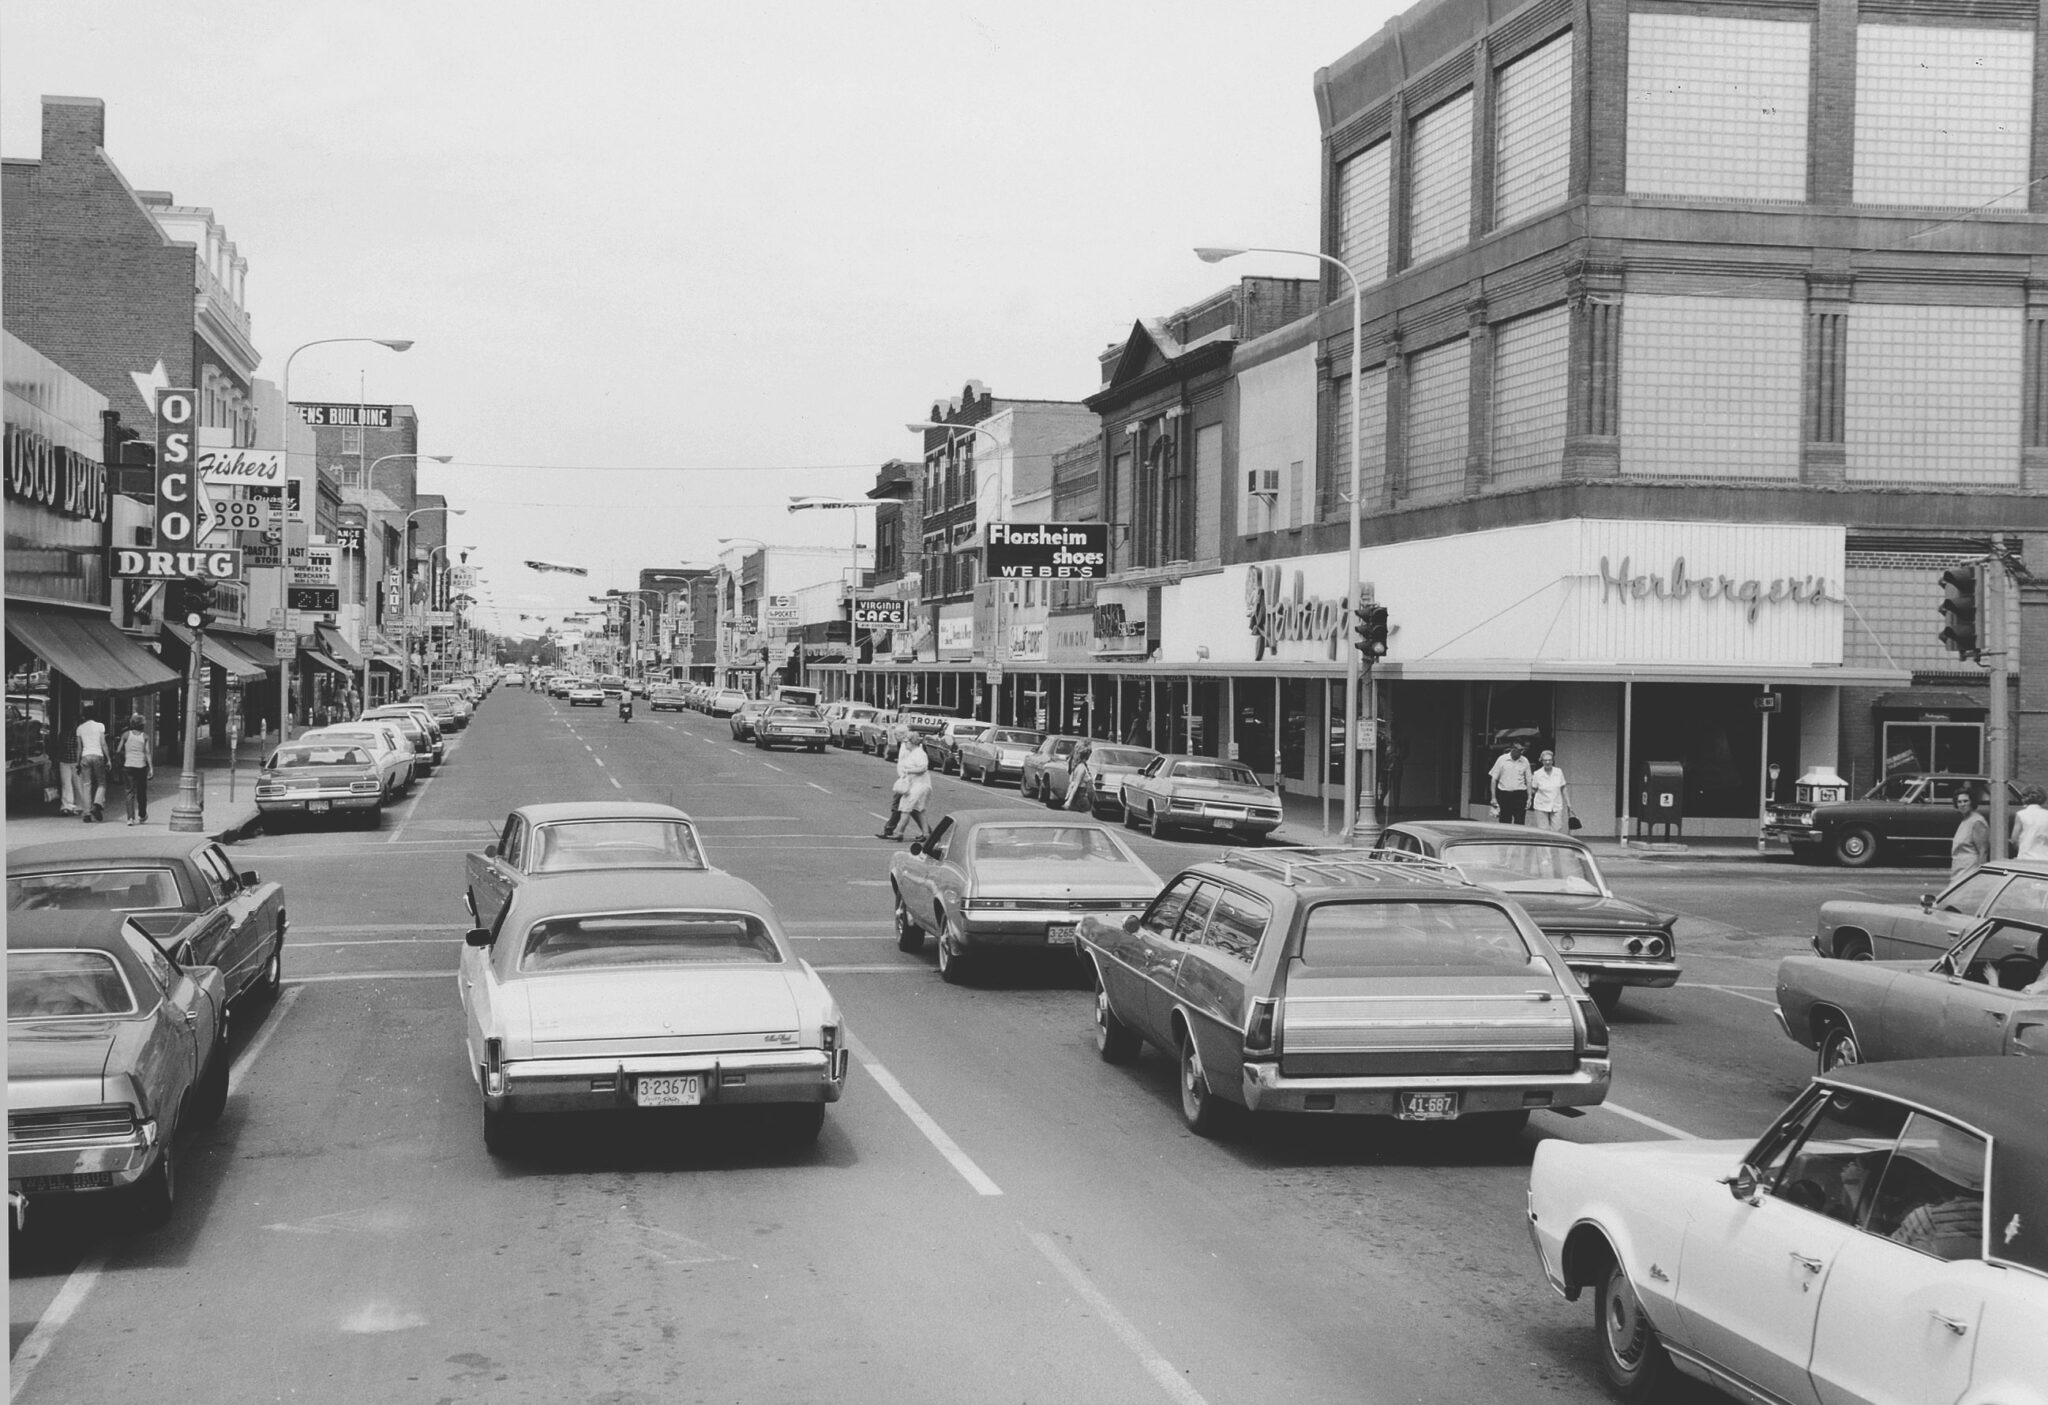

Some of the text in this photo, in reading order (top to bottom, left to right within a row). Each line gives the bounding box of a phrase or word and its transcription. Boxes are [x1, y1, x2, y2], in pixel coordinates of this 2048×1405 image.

[329, 407, 387, 426] BUILDING
[11, 422, 107, 523] OSCO DRUG
[161, 394, 192, 541] OSCO
[198, 451, 278, 480] Fisher's
[207, 501, 257, 515] OOD
[990, 524, 1087, 545] Florsheim
[242, 545, 267, 556] COAST
[269, 546, 279, 556] TO
[254, 556, 292, 564] STORS
[1052, 546, 1104, 565] shoes
[118, 551, 234, 578] DRUG
[1001, 565, 1093, 578] WEBB'S
[1600, 555, 1846, 624] Herberger's
[297, 590, 335, 609] 2:14
[860, 601, 902, 610] VIRGINIA
[855, 610, 902, 622] CAFE
[73, 1172, 109, 1185] DRUG
